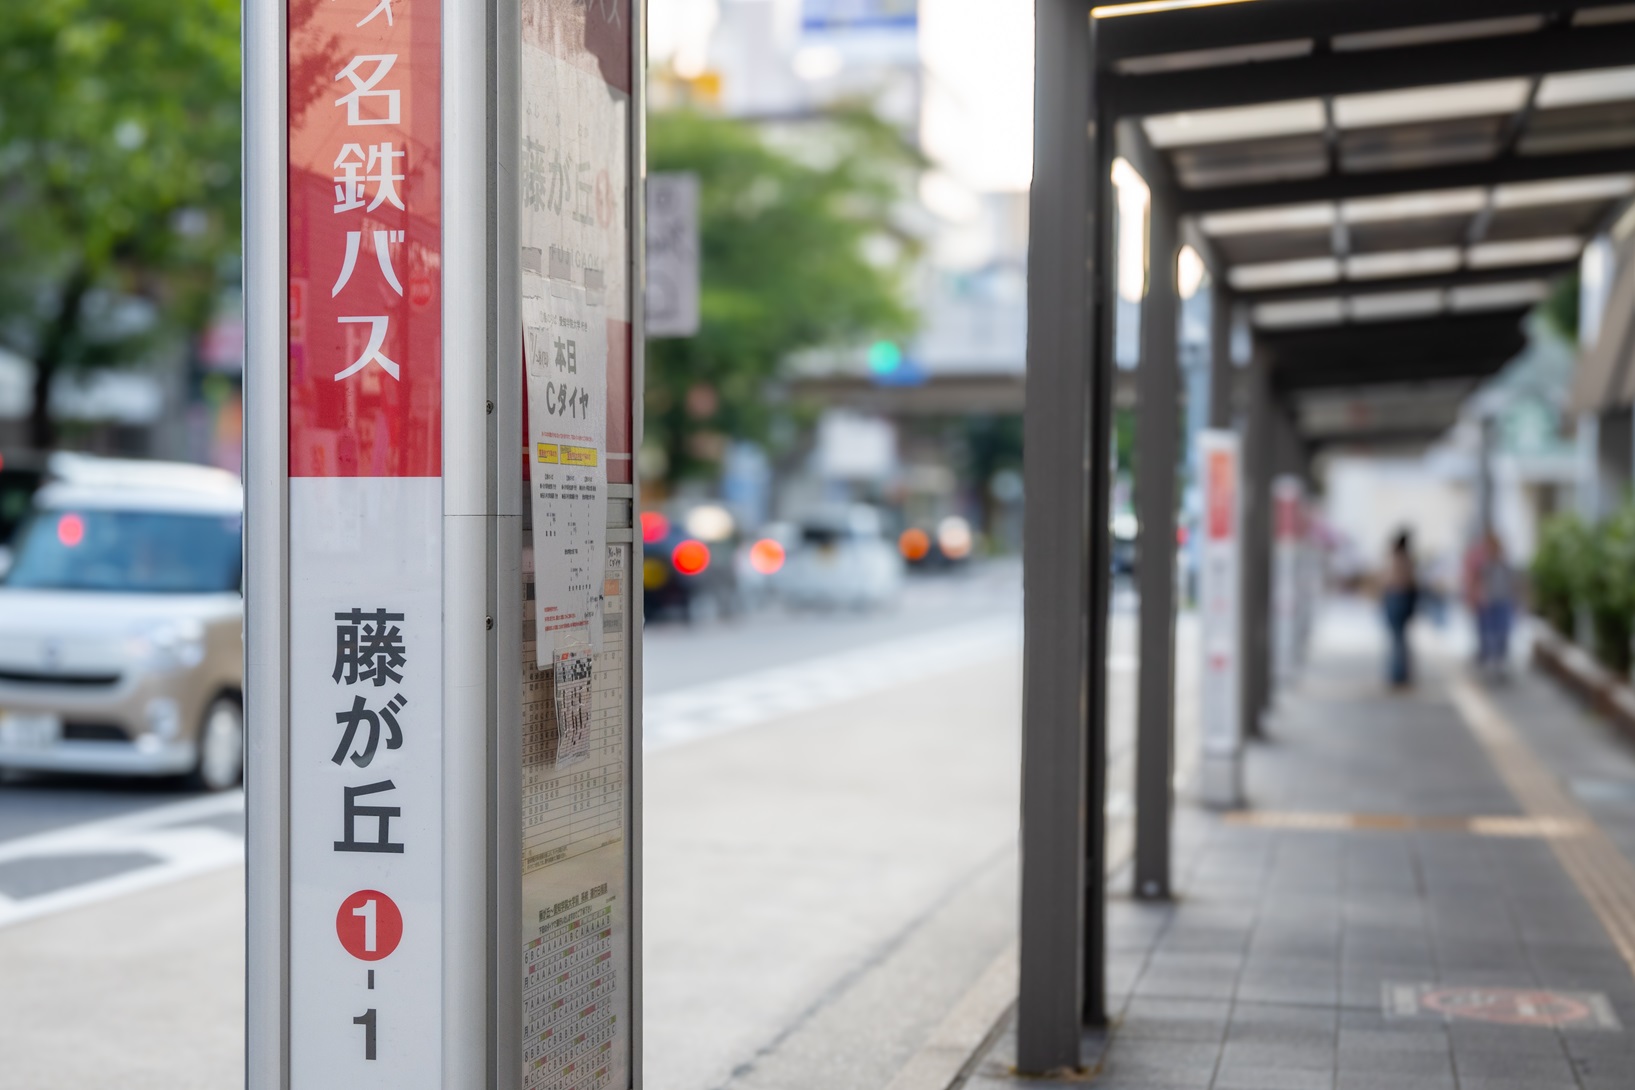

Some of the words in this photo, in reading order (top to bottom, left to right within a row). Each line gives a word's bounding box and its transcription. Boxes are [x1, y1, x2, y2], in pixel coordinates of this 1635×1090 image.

[332, 54, 405, 381] 名鉄バス
[546, 381, 589, 419] Cダイヤ
[553, 336, 577, 374] 本日
[331, 608, 408, 854] 藤が丘
